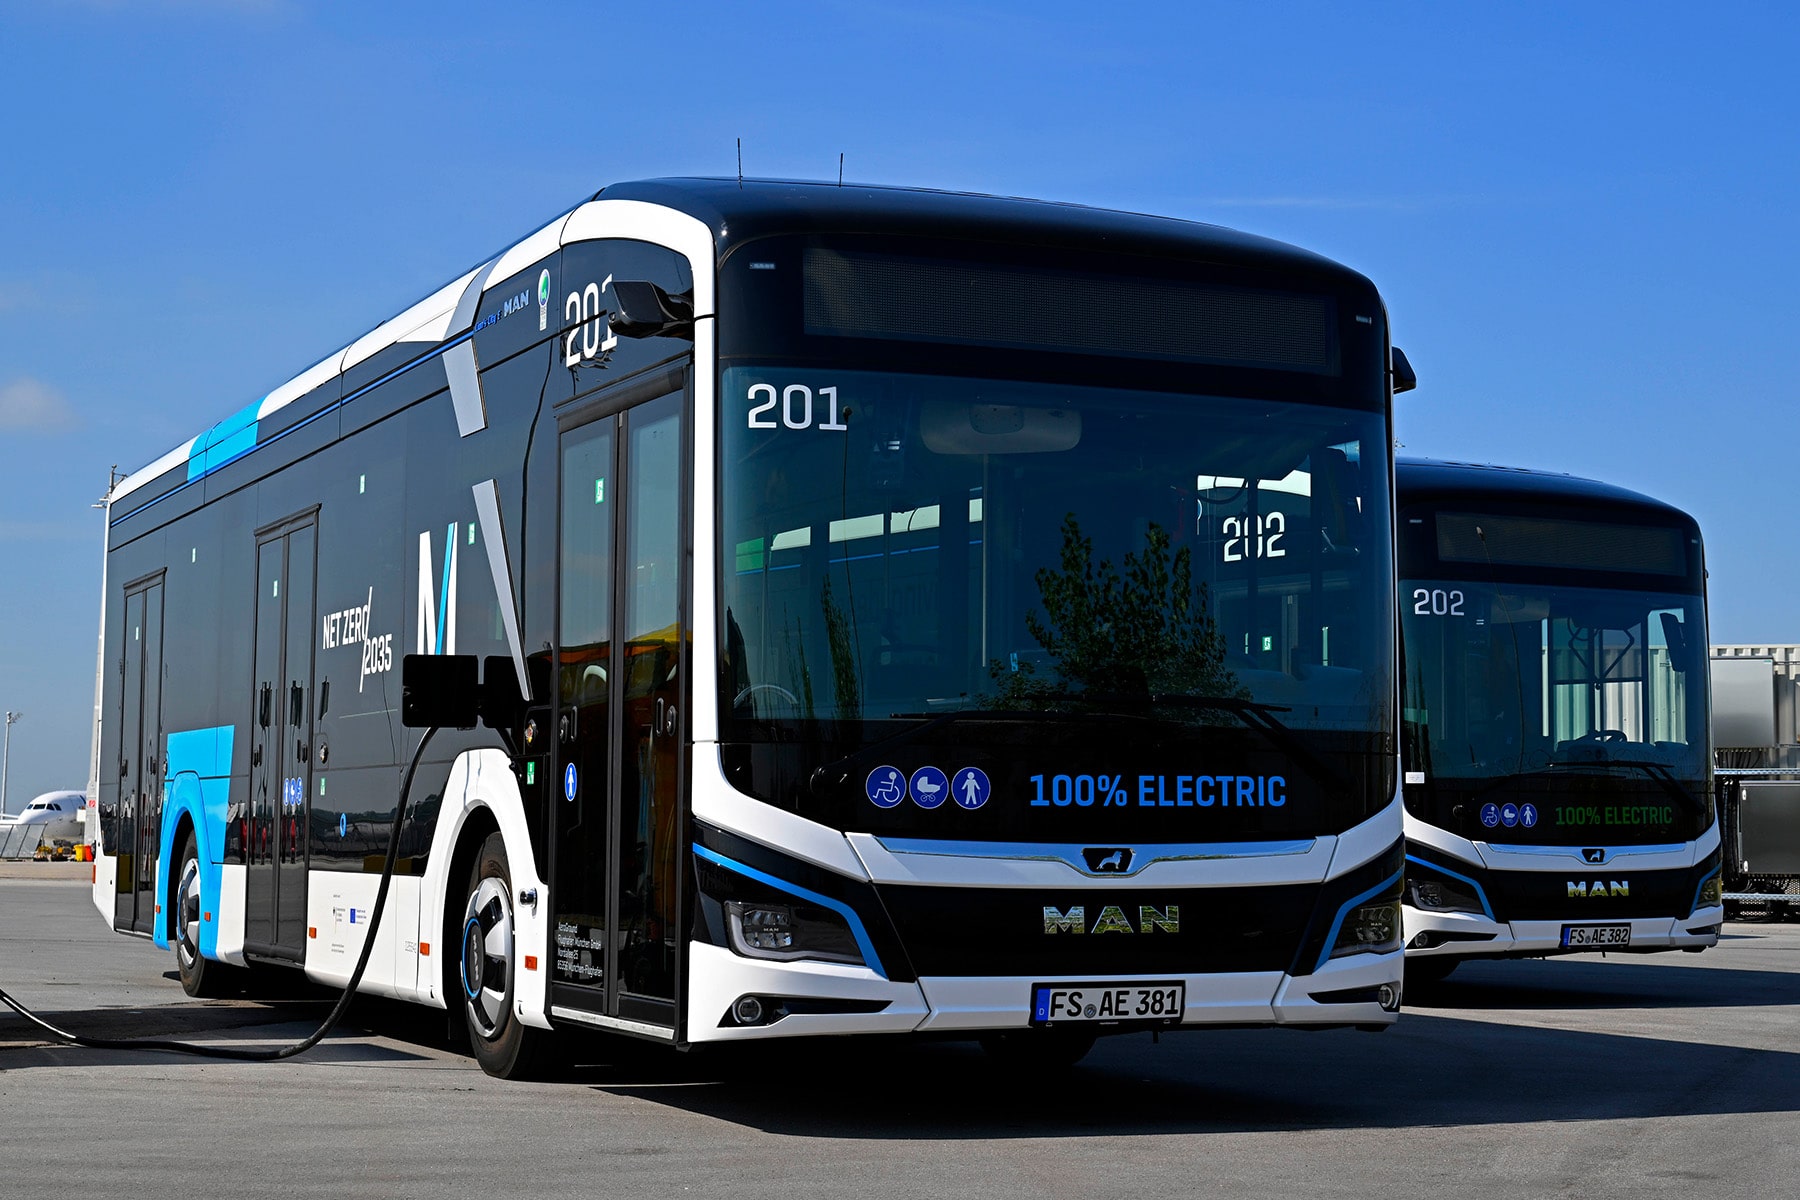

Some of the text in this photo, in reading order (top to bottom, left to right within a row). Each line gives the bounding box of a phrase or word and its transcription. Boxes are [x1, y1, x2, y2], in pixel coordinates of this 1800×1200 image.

[503, 289, 530, 317] MAN
[566, 273, 618, 367] 201
[747, 383, 848, 431] 201
[1222, 511, 1286, 562] 202
[1413, 588, 1465, 616] 202
[323, 604, 370, 650] NET ZERO
[363, 633, 393, 675] 2035
[1030, 774, 1286, 807] 100% ELECTRIC
[1555, 806, 1673, 825] 100% ELECTRIC
[1566, 880, 1630, 897] MAN
[1043, 905, 1180, 934] MAN
[1569, 928, 1629, 944] FS AE 382
[1050, 991, 1083, 1018] FS
[1098, 990, 1130, 1017] AE
[1135, 989, 1179, 1016] 381
